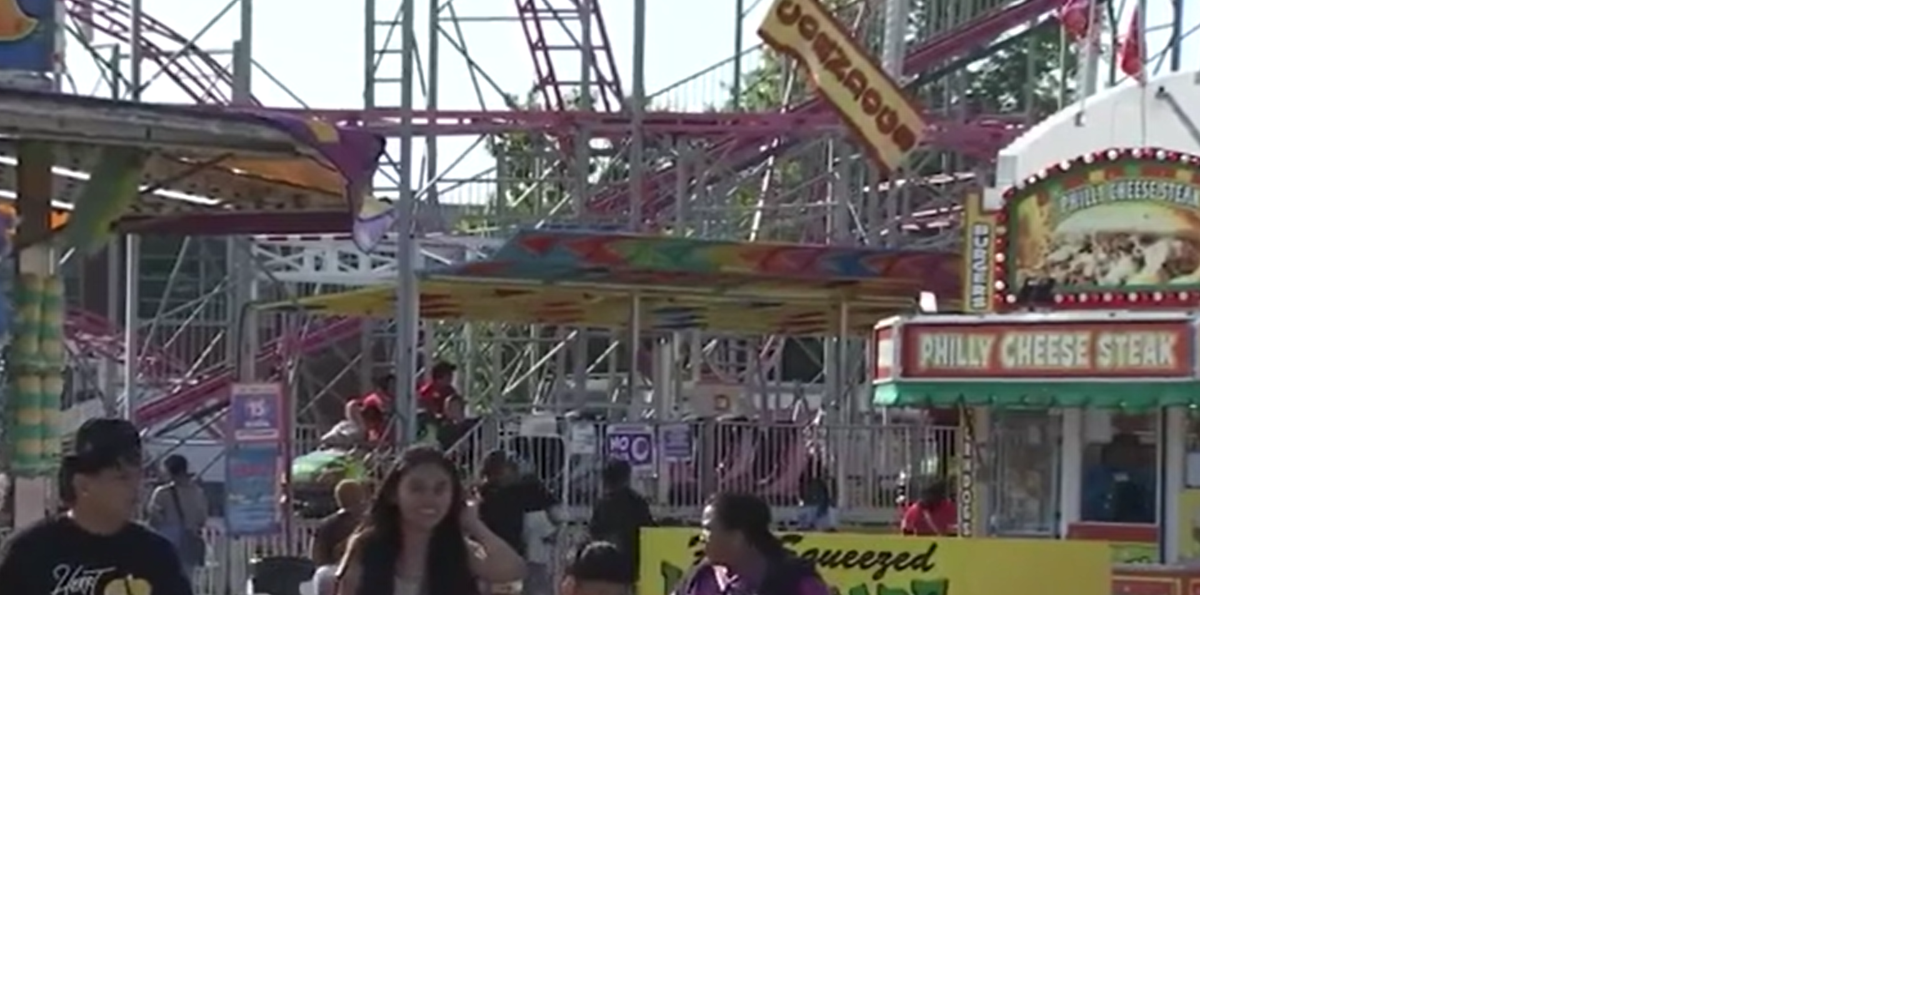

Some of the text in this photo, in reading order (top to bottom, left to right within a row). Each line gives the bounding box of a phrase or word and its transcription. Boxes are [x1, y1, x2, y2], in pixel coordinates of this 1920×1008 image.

[1060, 187, 1103, 212] PHILLY
[1109, 181, 1158, 199] CHEESE
[919, 331, 1176, 369] PHILLY CHEESE STEAK
